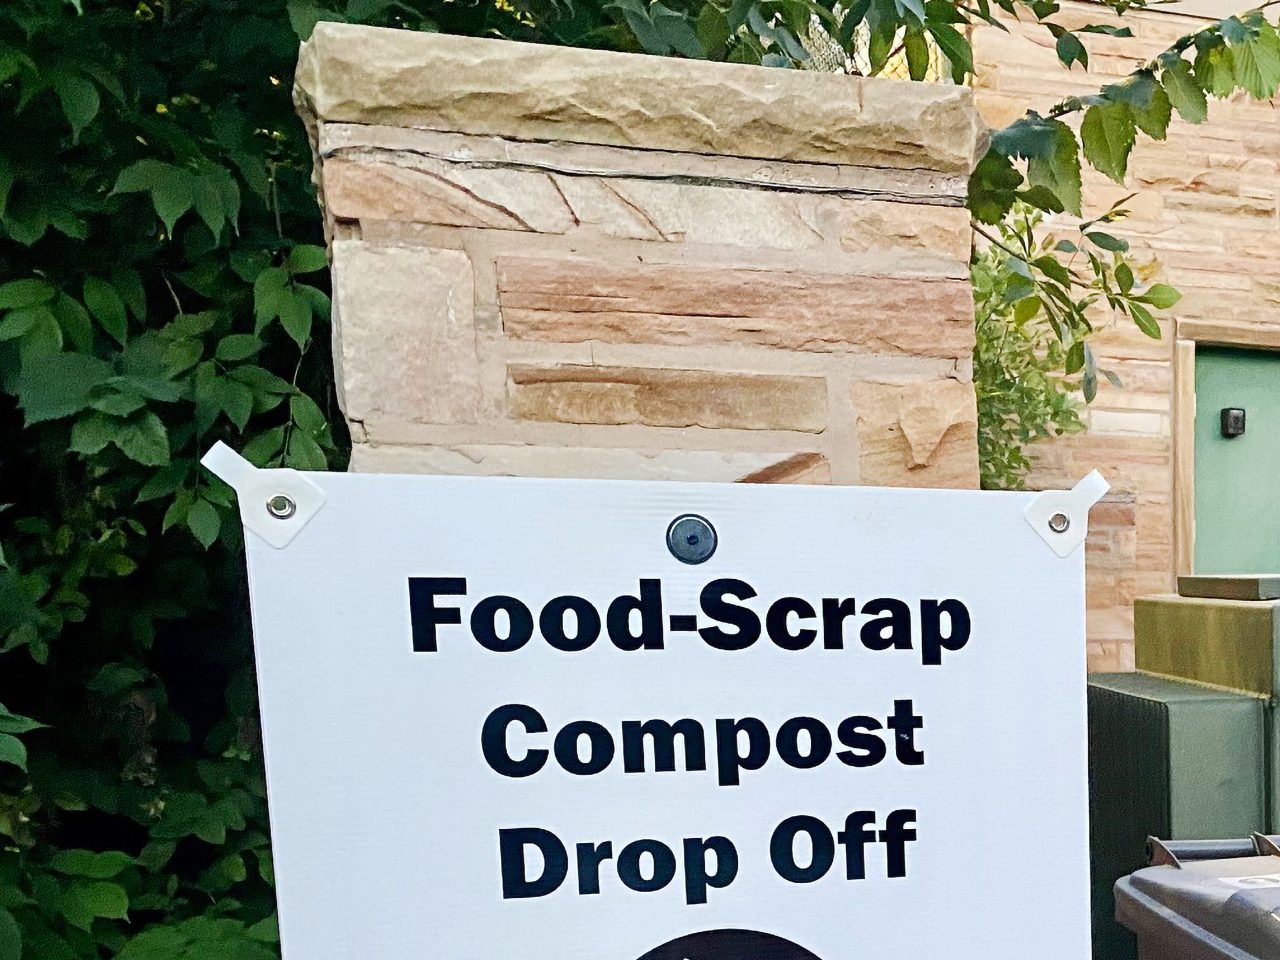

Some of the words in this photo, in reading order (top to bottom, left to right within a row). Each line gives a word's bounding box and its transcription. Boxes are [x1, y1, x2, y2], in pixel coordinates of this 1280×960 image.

[408, 576, 972, 666] Food-Scrap
[481, 699, 925, 787] Compost
[498, 827, 739, 905] Drop
[769, 809, 918, 884] Off
